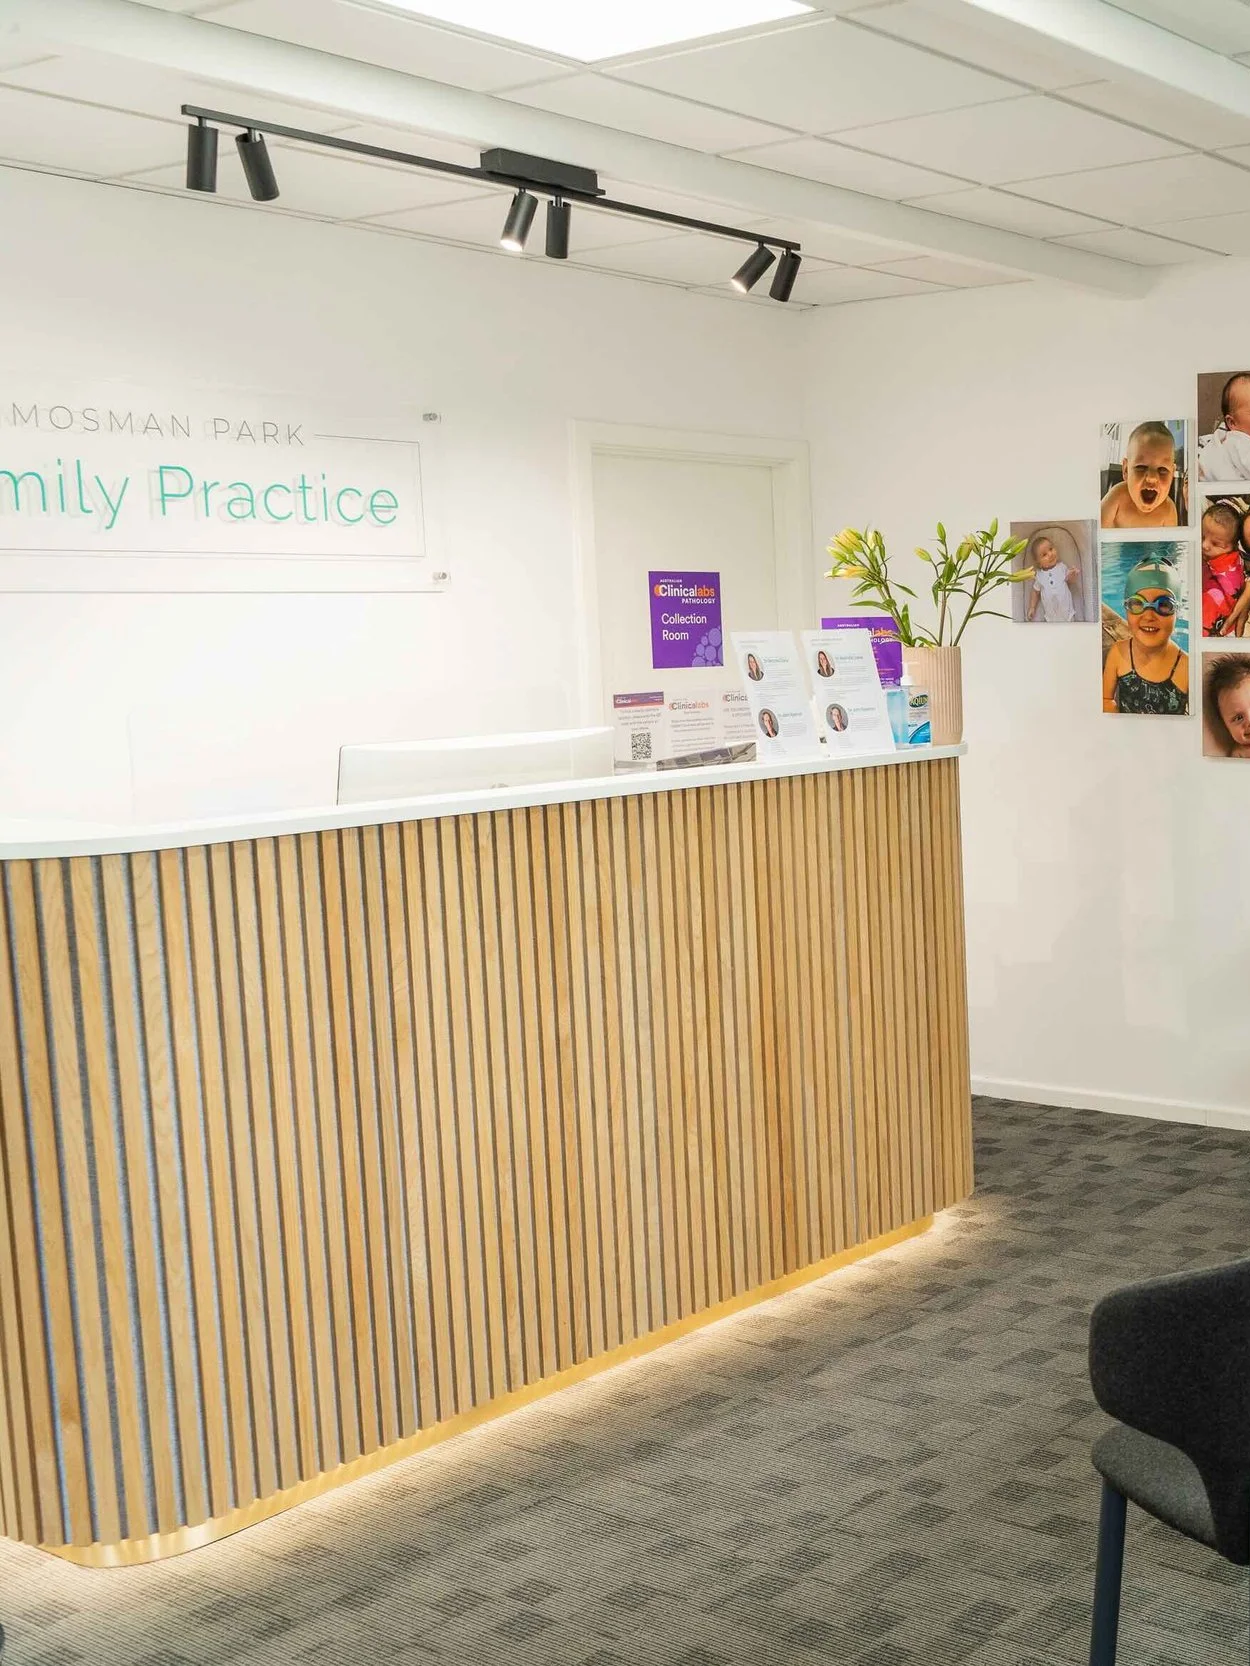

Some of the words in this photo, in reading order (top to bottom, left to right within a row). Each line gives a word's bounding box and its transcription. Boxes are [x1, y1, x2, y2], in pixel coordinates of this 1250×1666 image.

[12, 402, 191, 438] MOSMAN
[213, 417, 304, 445] PARK
[158, 465, 399, 524] Practice
[659, 584, 715, 597] Clinicalabs
[661, 613, 707, 624] Collection
[662, 629, 689, 641] Room
